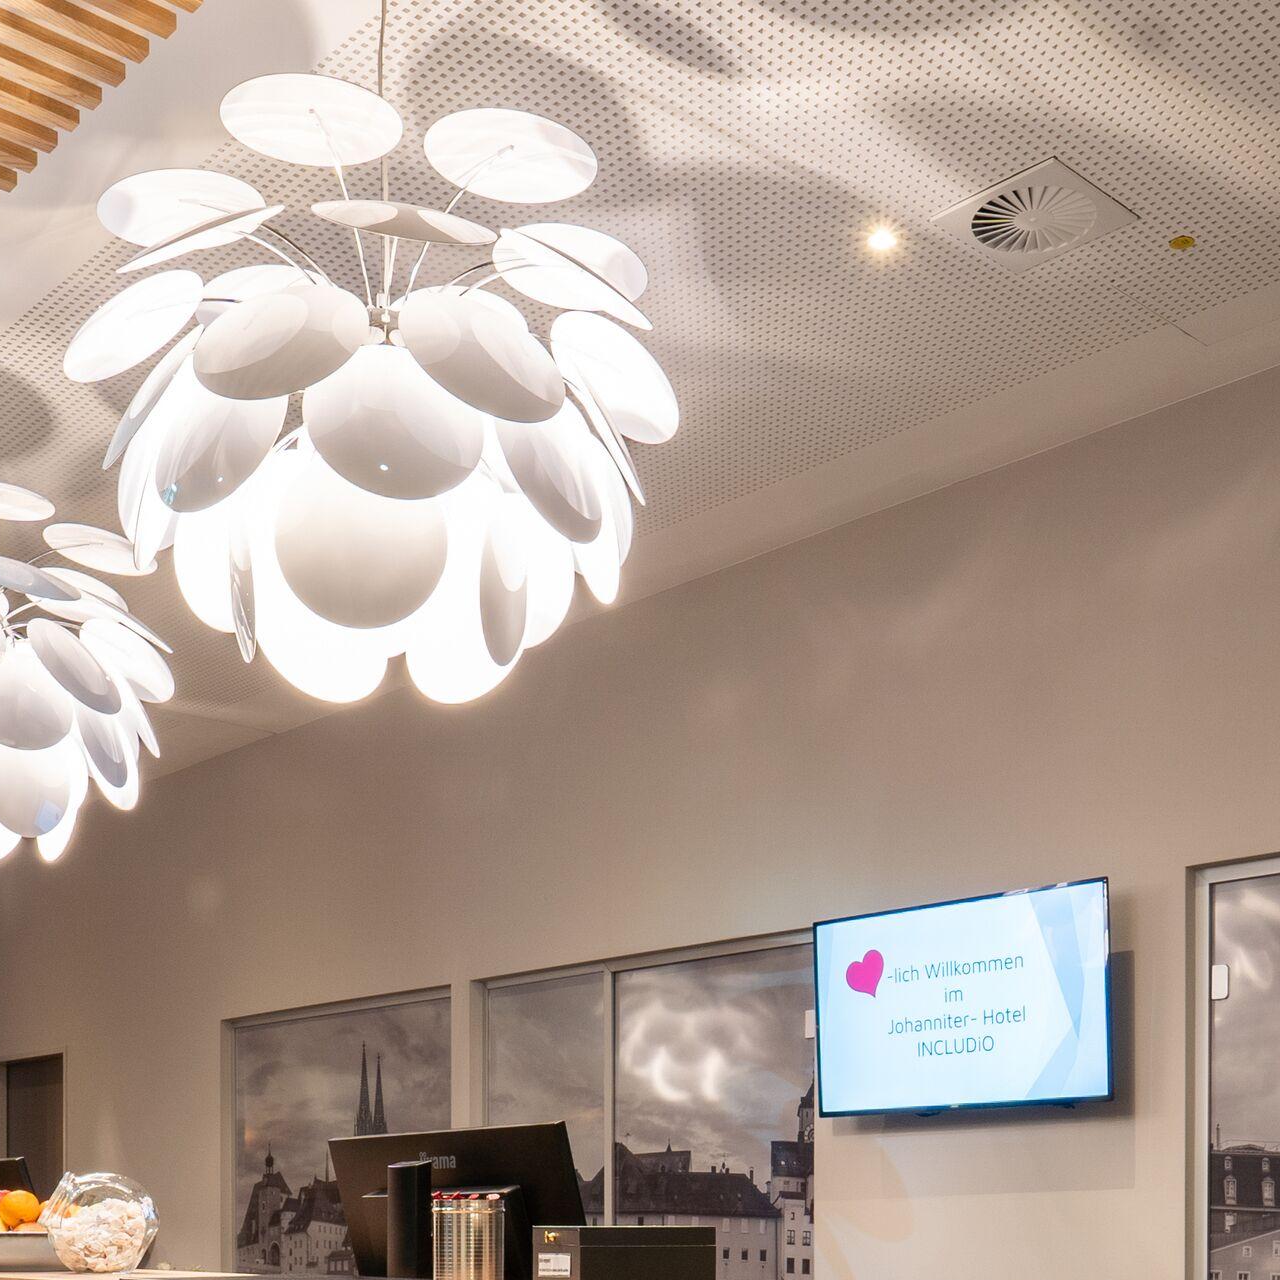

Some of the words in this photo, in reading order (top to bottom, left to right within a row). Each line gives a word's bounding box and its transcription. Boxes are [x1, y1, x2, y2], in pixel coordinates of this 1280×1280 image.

[887, 964, 920, 984] -lich
[924, 955, 1024, 980] Willkommen
[944, 987, 963, 1003] im
[887, 1013, 977, 1035] Johanniter-
[983, 1005, 1026, 1026] Hotel
[917, 1035, 995, 1057] INCLUDiO
